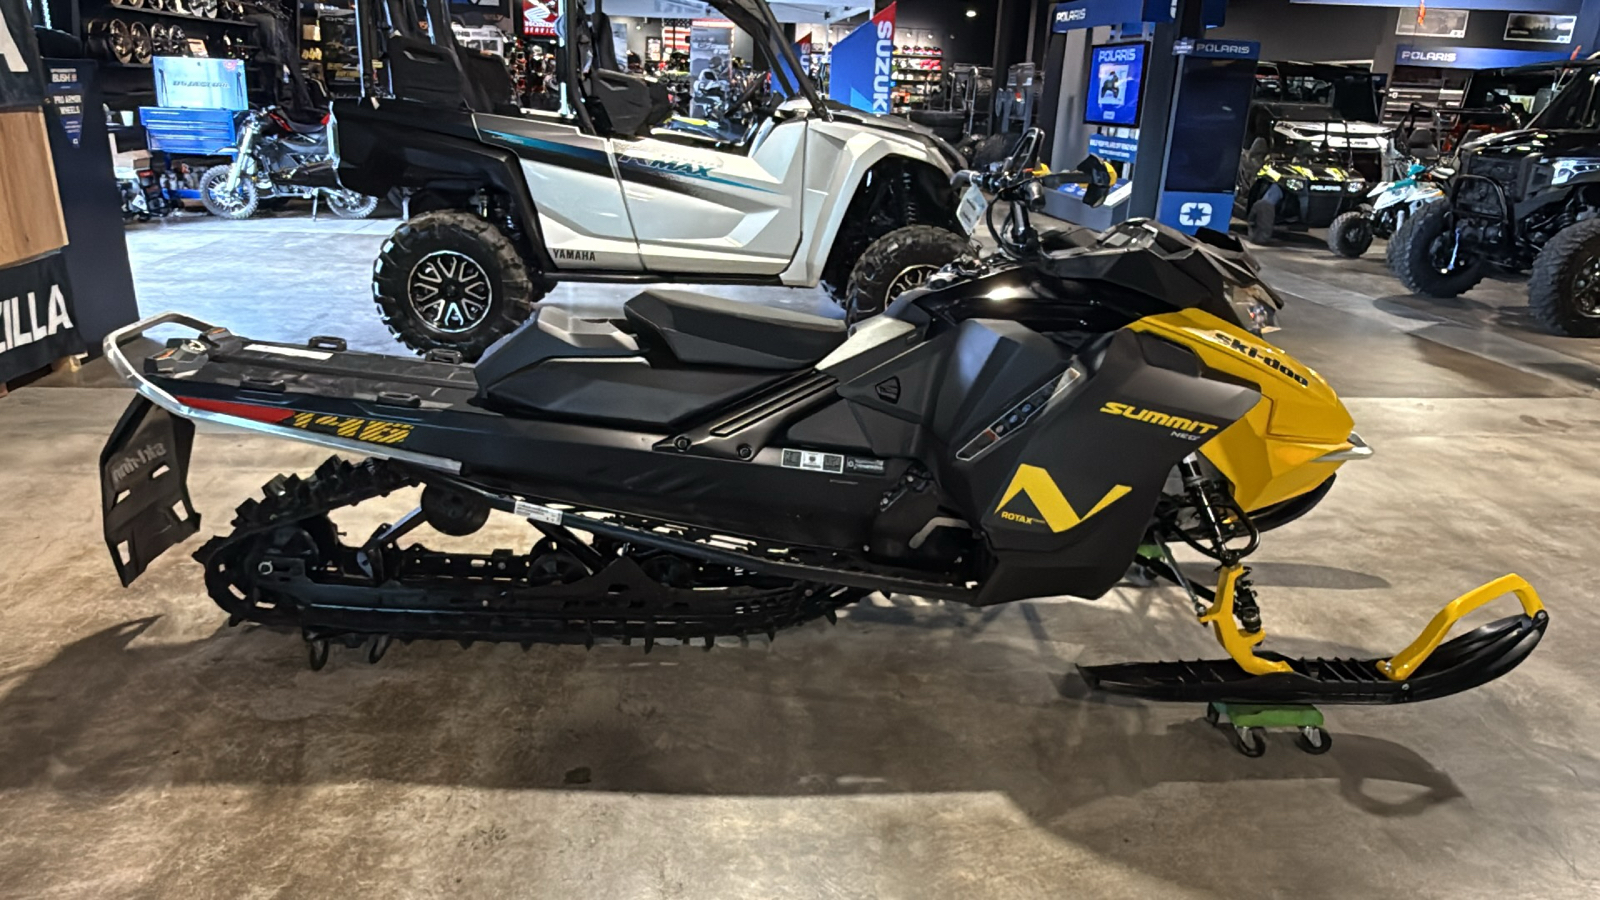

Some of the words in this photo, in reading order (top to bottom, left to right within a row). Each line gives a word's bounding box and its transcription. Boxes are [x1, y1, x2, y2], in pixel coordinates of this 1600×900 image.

[1056, 8, 1086, 22] POLARIS
[1098, 48, 1136, 62] POLARIS
[1196, 43, 1250, 54] POLARIS
[1402, 51, 1457, 62] POLARIS
[552, 248, 596, 261] YAMAHA
[1100, 402, 1218, 434] SUMMIT
[1001, 511, 1033, 524] ROTAX
